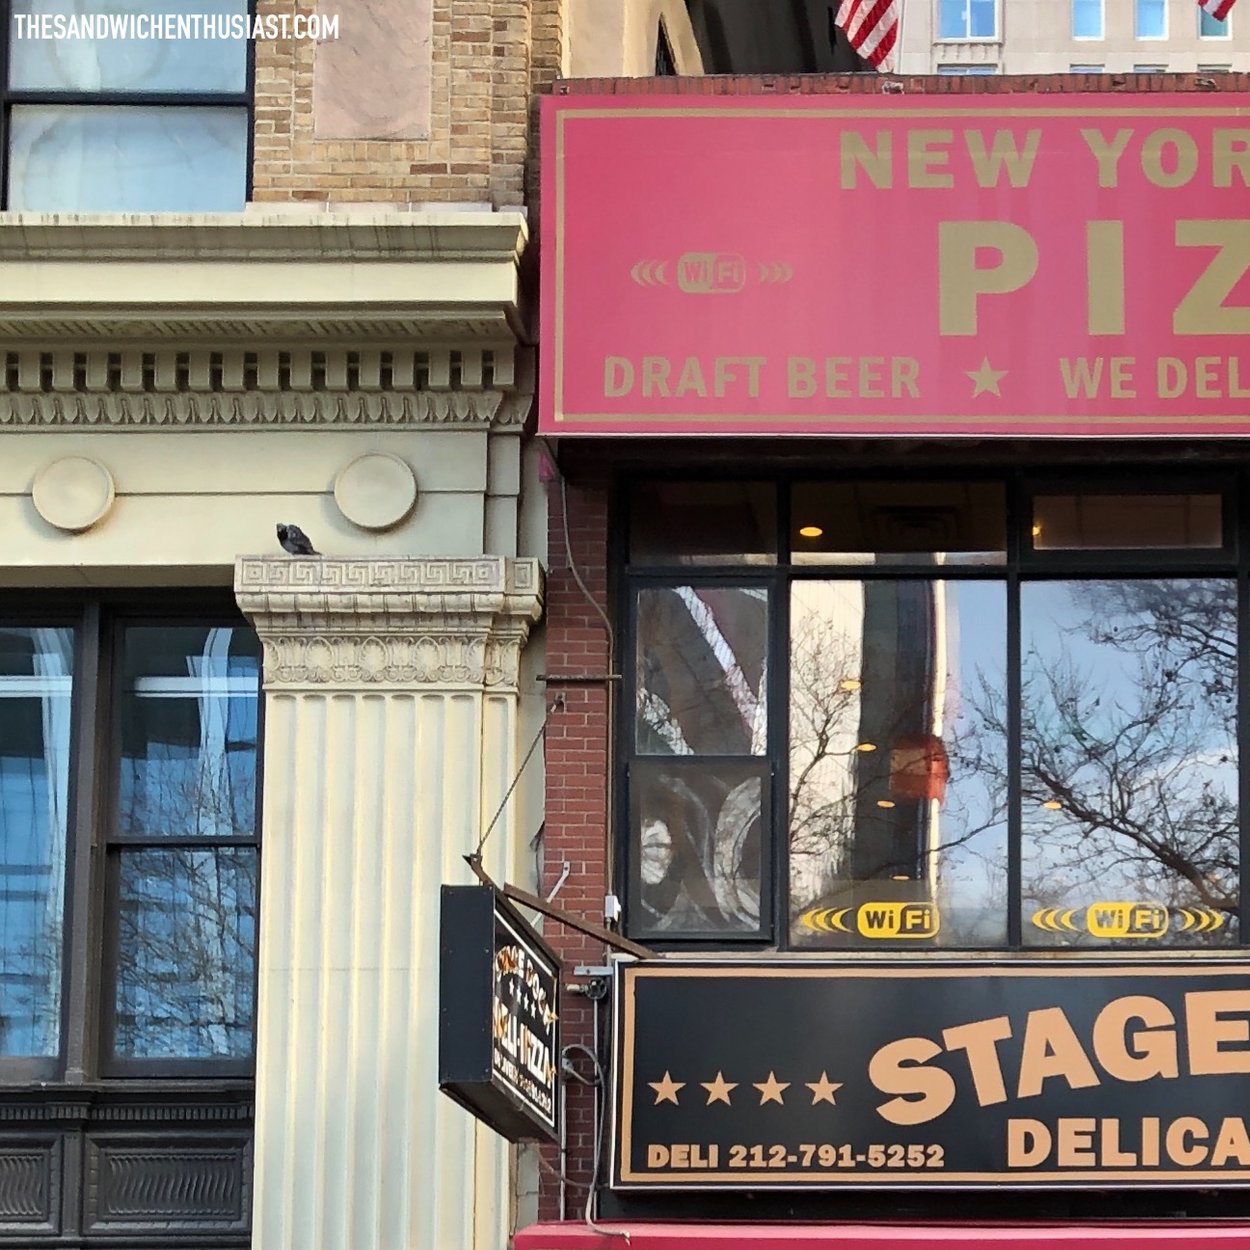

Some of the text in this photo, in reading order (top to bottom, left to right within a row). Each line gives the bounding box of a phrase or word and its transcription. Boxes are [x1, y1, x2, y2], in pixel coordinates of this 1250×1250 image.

[840, 127, 1043, 190] NEW
[603, 355, 921, 399] DRAFT BEER
[1060, 357, 1138, 399] WE
[647, 1143, 946, 1169] DELI 212-791-5252
